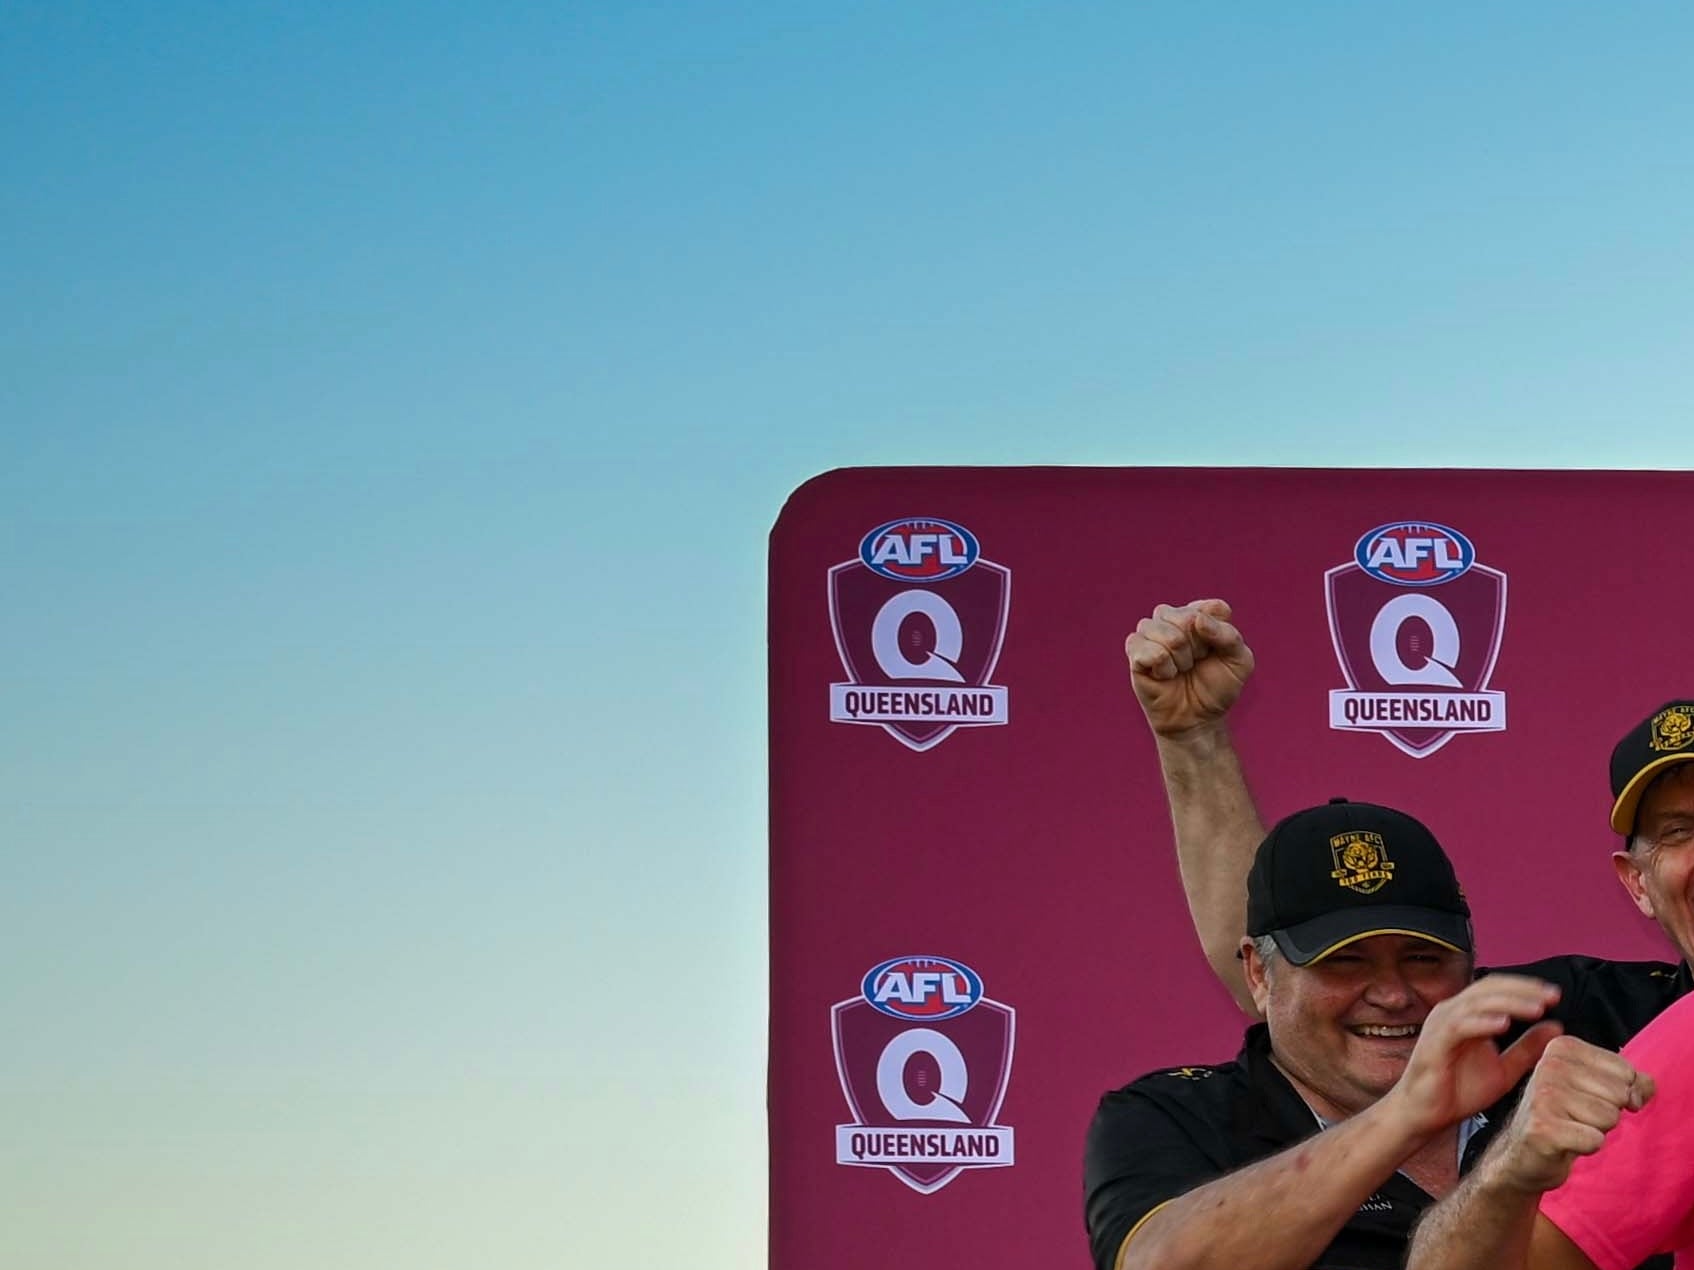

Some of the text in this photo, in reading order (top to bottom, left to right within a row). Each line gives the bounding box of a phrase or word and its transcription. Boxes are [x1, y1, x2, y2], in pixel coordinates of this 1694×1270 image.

[870, 536, 968, 565] AFL
[1365, 538, 1463, 568] AFL
[872, 588, 965, 681] Q
[1369, 593, 1463, 687] Q
[844, 692, 994, 717] QUEENSLAND
[1344, 698, 1491, 722] QUEENSLAND
[873, 972, 971, 1003] AFL
[877, 1029, 969, 1123] Q
[850, 1131, 1000, 1158] QUEENSLAND
